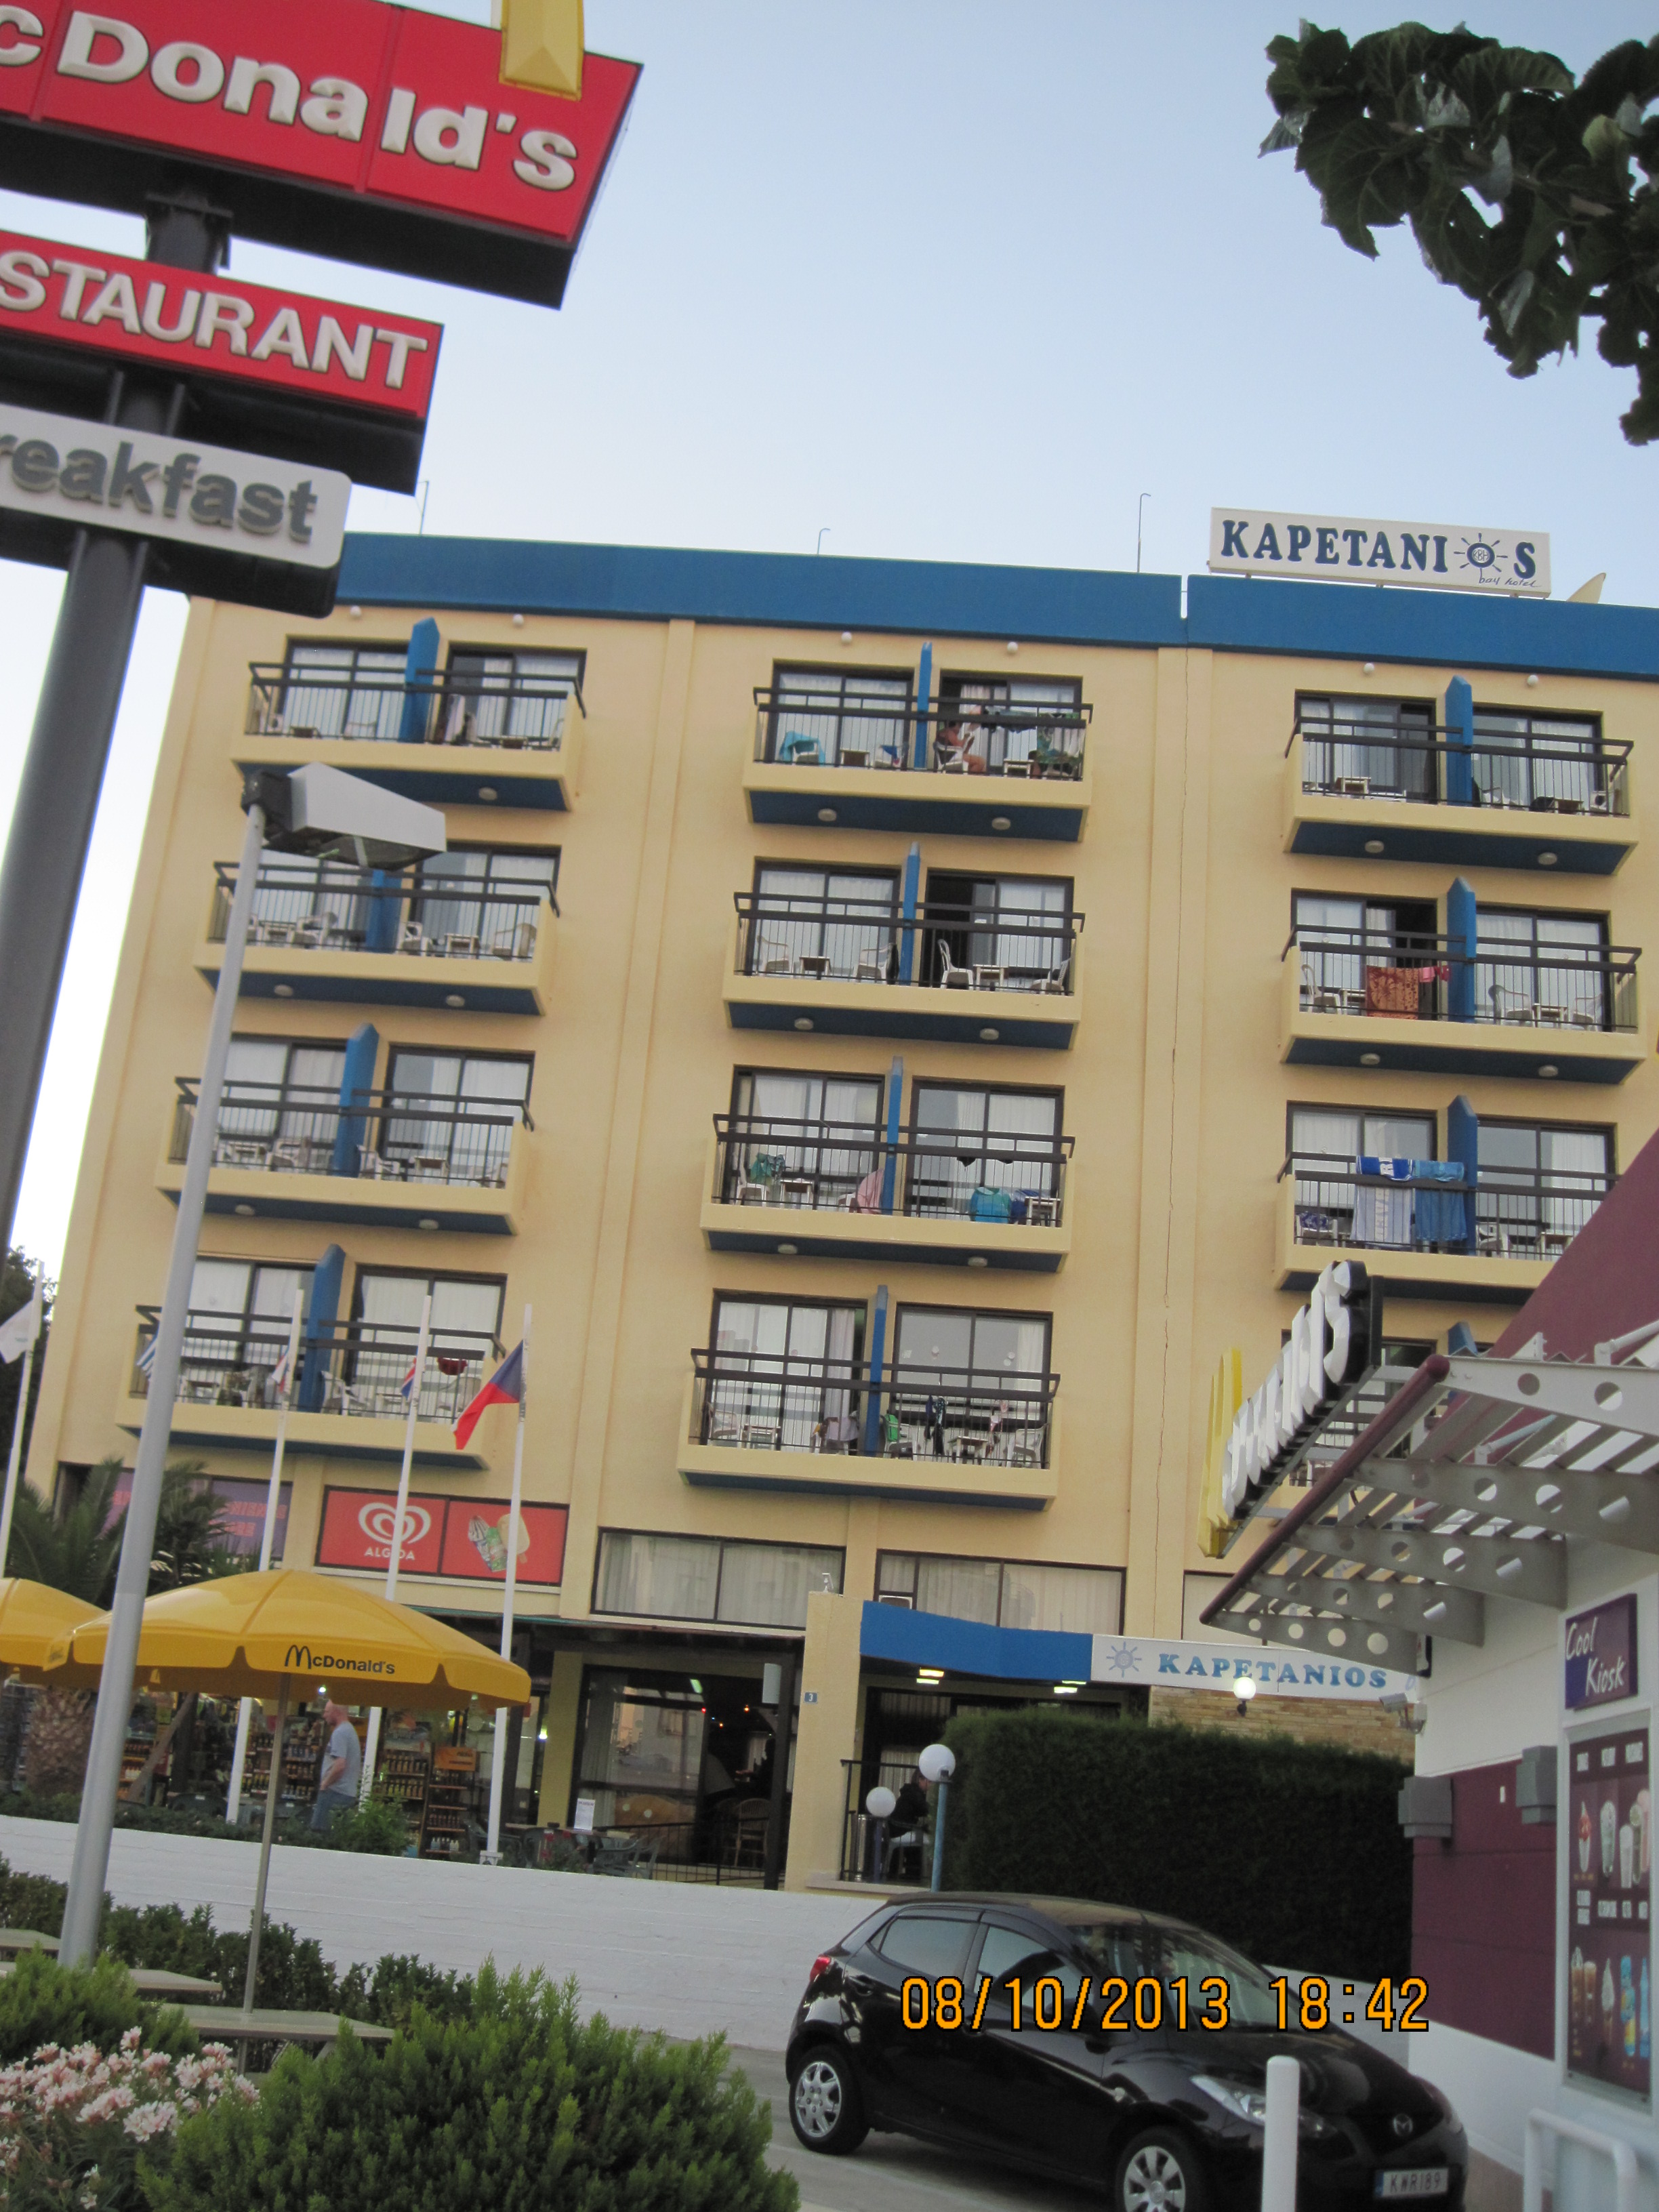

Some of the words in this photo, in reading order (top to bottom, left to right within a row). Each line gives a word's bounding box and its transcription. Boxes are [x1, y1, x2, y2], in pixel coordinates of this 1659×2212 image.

[0, 251, 428, 390] STAURANT
[1504, 577, 1543, 588] hotel
[363, 1547, 415, 1561] ALGDA
[1566, 1615, 1598, 1661] Cool
[284, 1644, 396, 1675] McDonald's
[1158, 1653, 1387, 1689] KAPETANIOS
[1585, 1654, 1626, 1696] Kiosk
